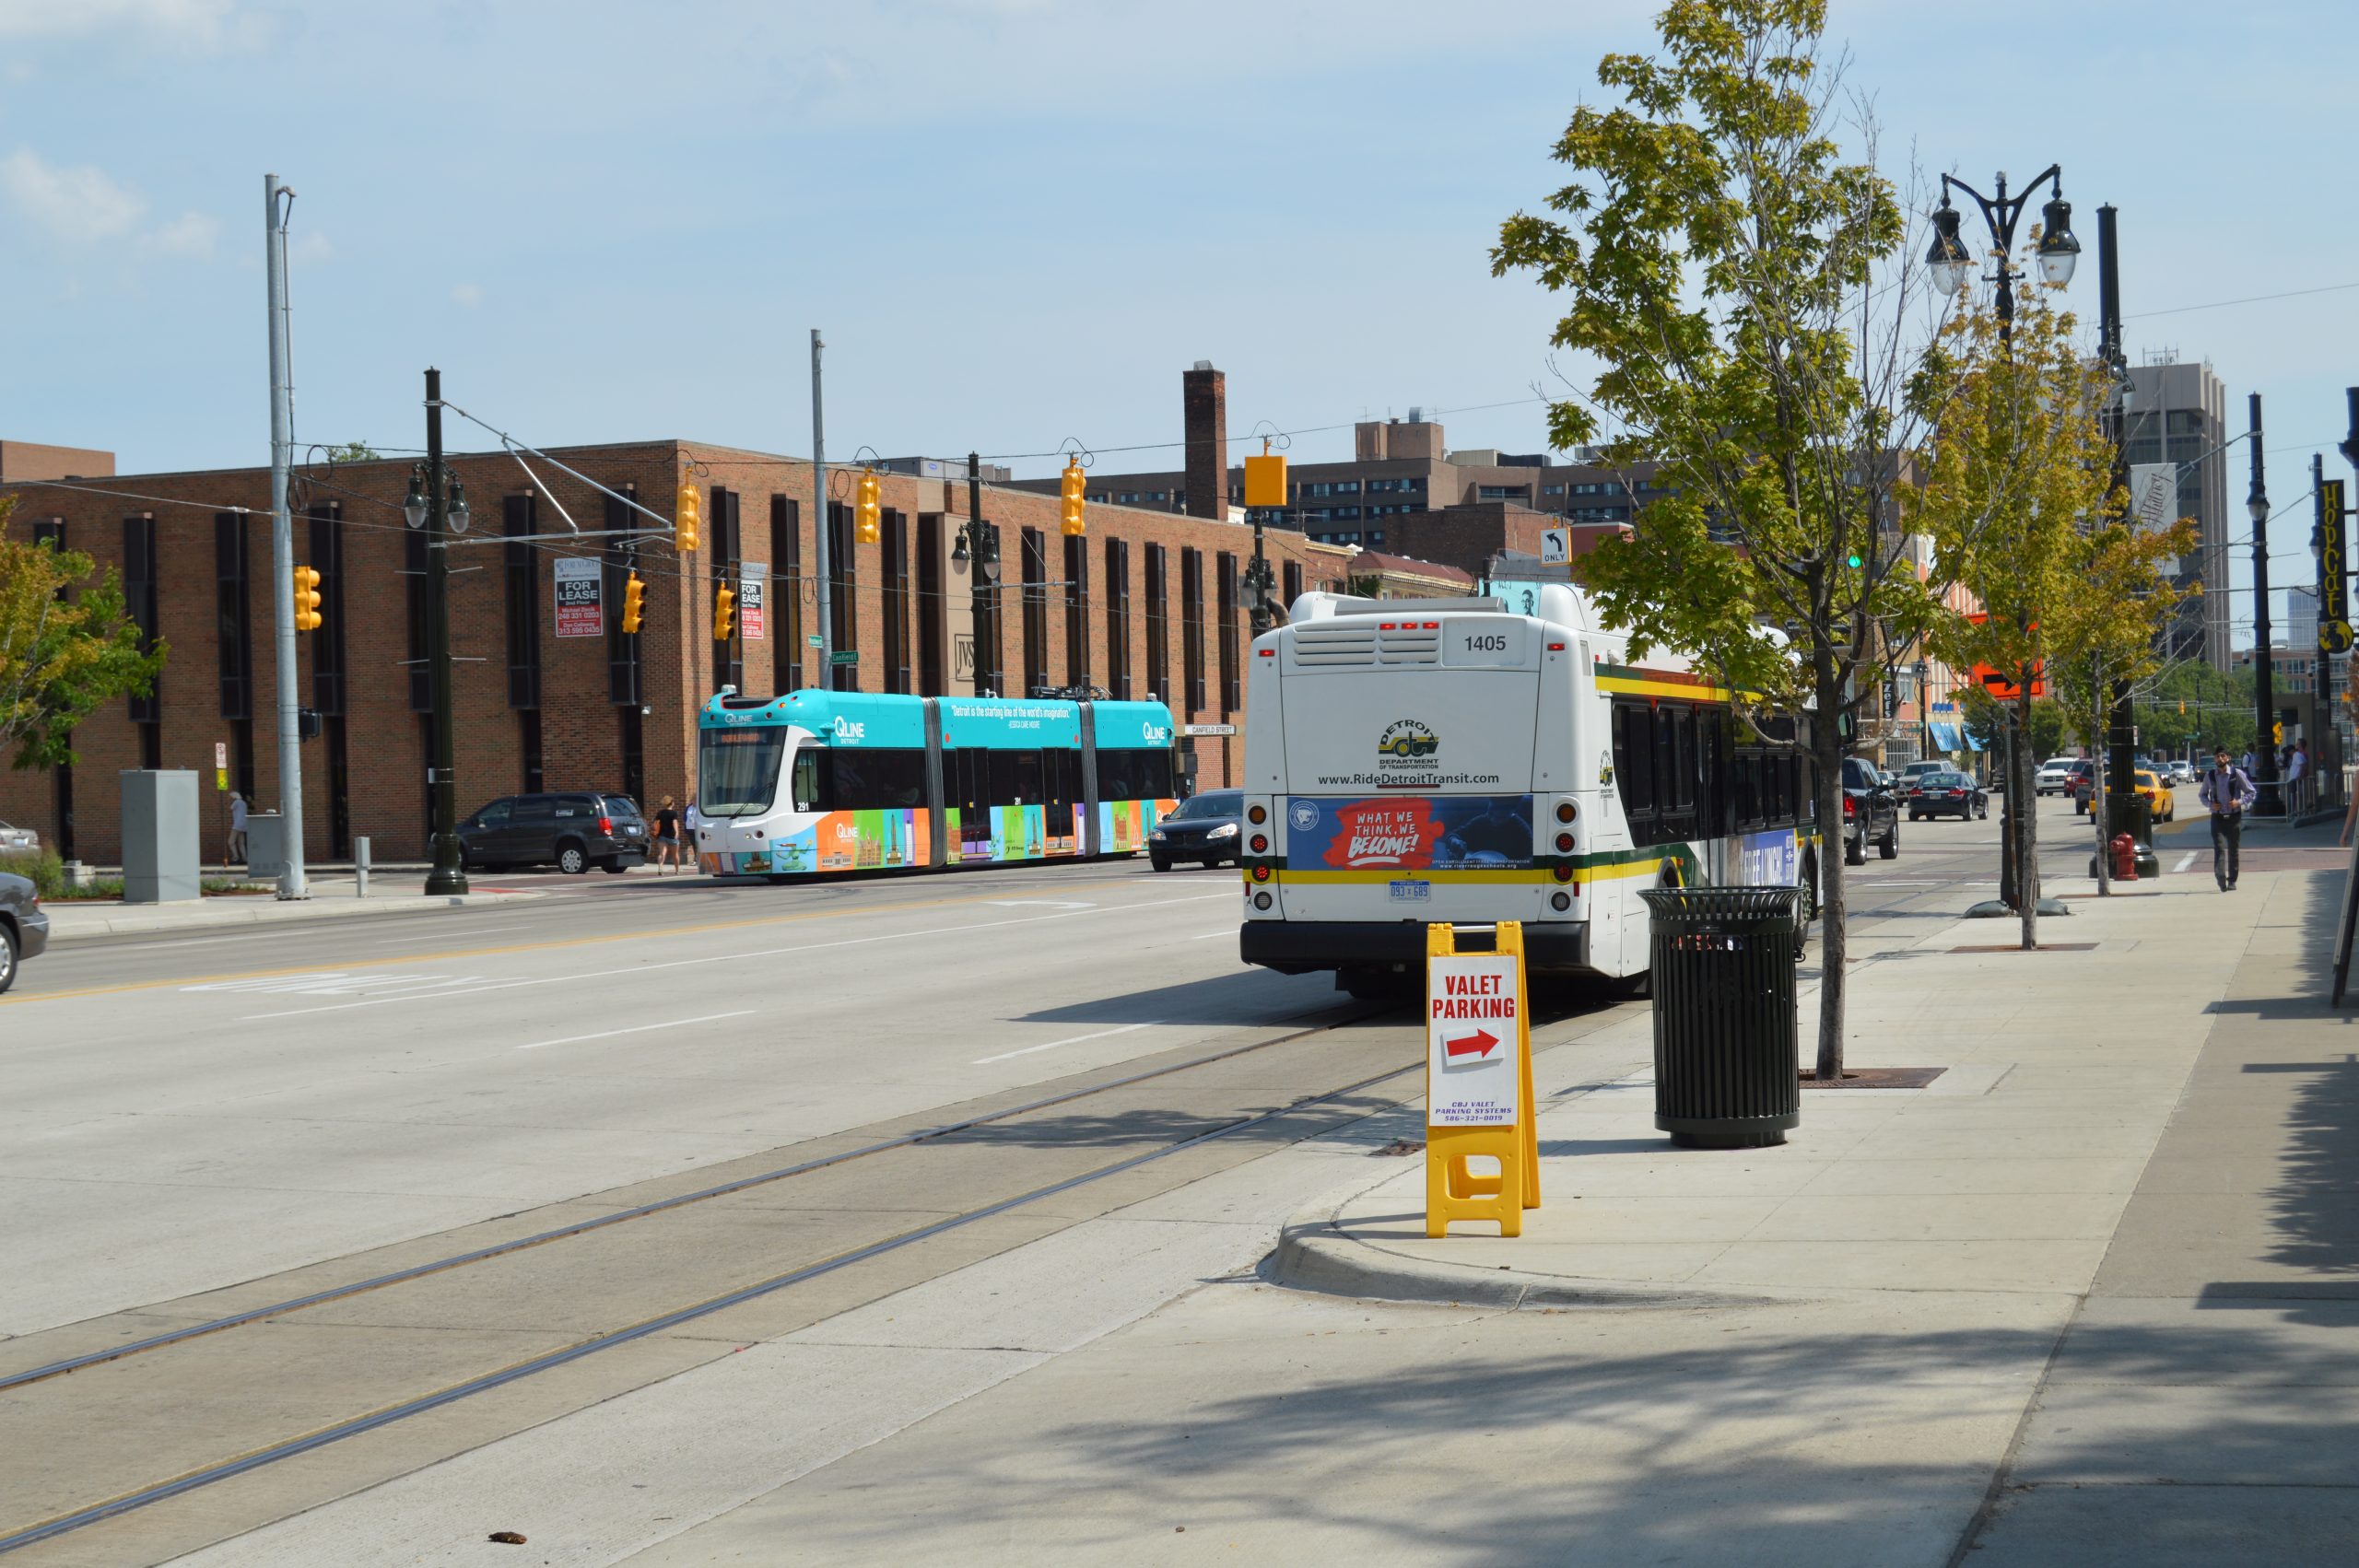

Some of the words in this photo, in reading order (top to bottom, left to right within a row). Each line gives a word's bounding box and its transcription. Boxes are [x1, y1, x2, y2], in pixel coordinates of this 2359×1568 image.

[1544, 554, 1566, 562] ONLY
[565, 581, 591, 591] FOR
[742, 584, 757, 594] FOR
[558, 590, 598, 601] LEASE
[742, 593, 761, 604] EASE
[1464, 636, 1507, 651] 1405
[724, 713, 753, 723] QLINE
[835, 715, 865, 738] QLINE
[1143, 721, 1166, 741] QLINE
[1380, 719, 1437, 745] DETROIT
[1318, 773, 1500, 786] www.RideDetroitTransit.com
[797, 802, 809, 812] 291
[1356, 813, 1391, 824] WHAT
[1396, 812, 1414, 822] WE
[836, 823, 859, 838] QLINE
[1399, 824, 1416, 835] WE
[1391, 885, 1405, 897] 093
[1414, 885, 1428, 897] 689
[1445, 975, 1503, 996] VALET
[1432, 997, 1515, 1019] PARKING
